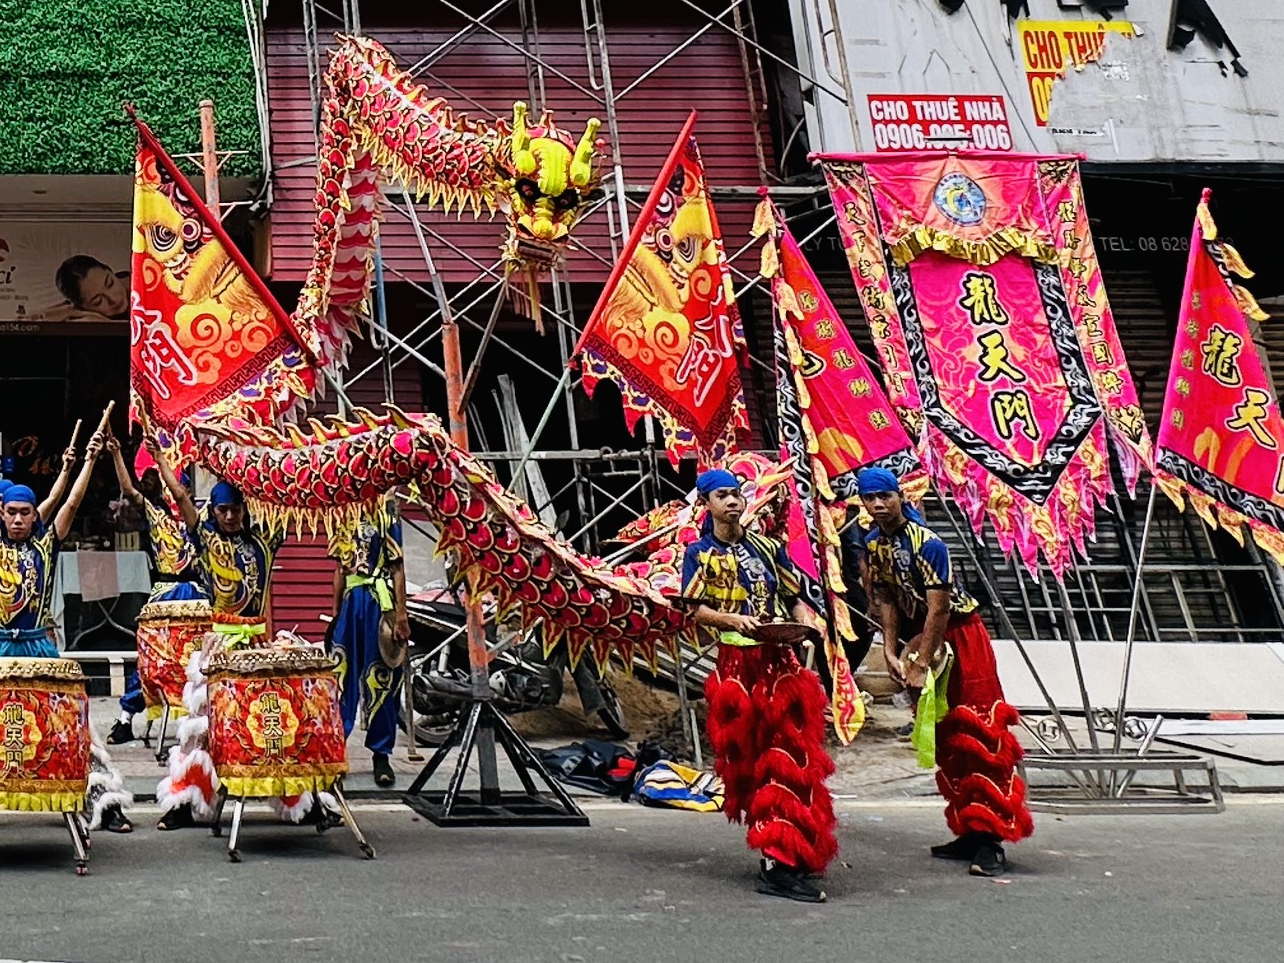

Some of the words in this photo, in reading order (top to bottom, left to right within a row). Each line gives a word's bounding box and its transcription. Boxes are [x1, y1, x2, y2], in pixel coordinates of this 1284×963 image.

[1023, 29, 1063, 70] CHO
[869, 99, 910, 121] CHO
[912, 97, 961, 121] THUÊ
[964, 96, 1006, 121] NHÀ
[1099, 236, 1135, 252] TEL:
[1138, 236, 1158, 252] 08
[1161, 236, 1190, 252] 628
